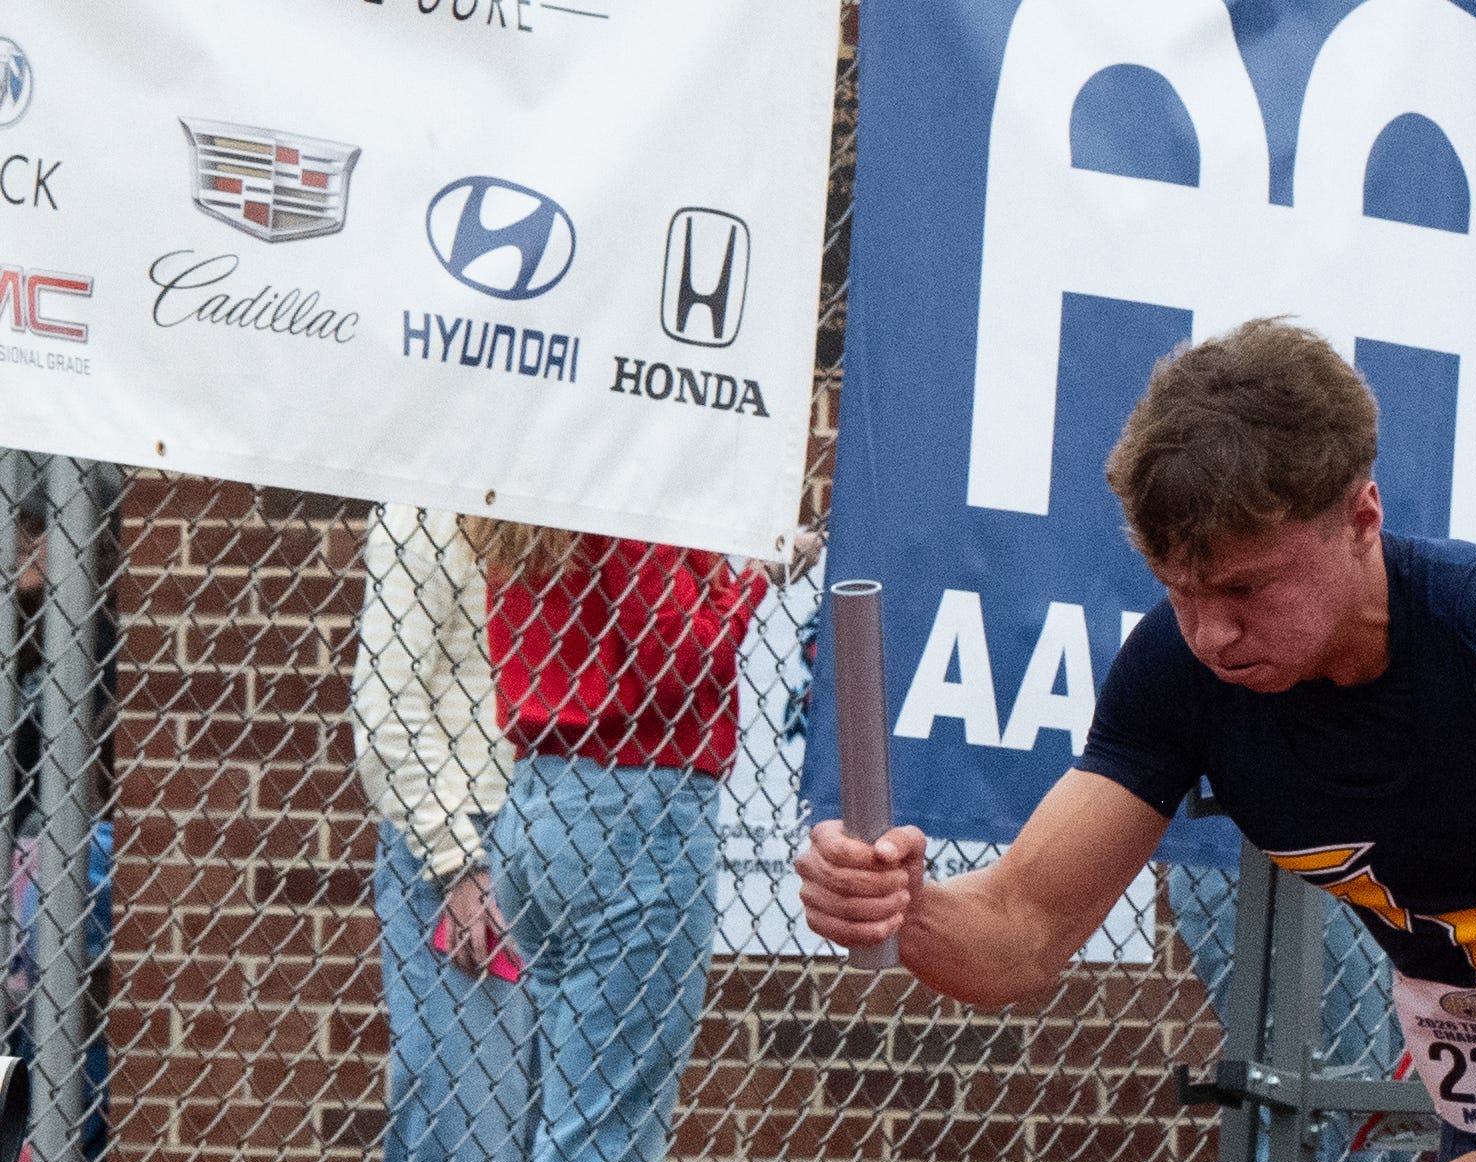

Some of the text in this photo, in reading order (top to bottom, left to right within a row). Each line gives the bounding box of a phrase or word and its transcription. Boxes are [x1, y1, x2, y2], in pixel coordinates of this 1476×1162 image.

[148, 249, 360, 343] Cadillac
[46, 352, 92, 376] GRADE
[403, 309, 580, 384] HYUNDAI
[609, 356, 771, 419] HONDA
[893, 588, 1145, 757] AA
